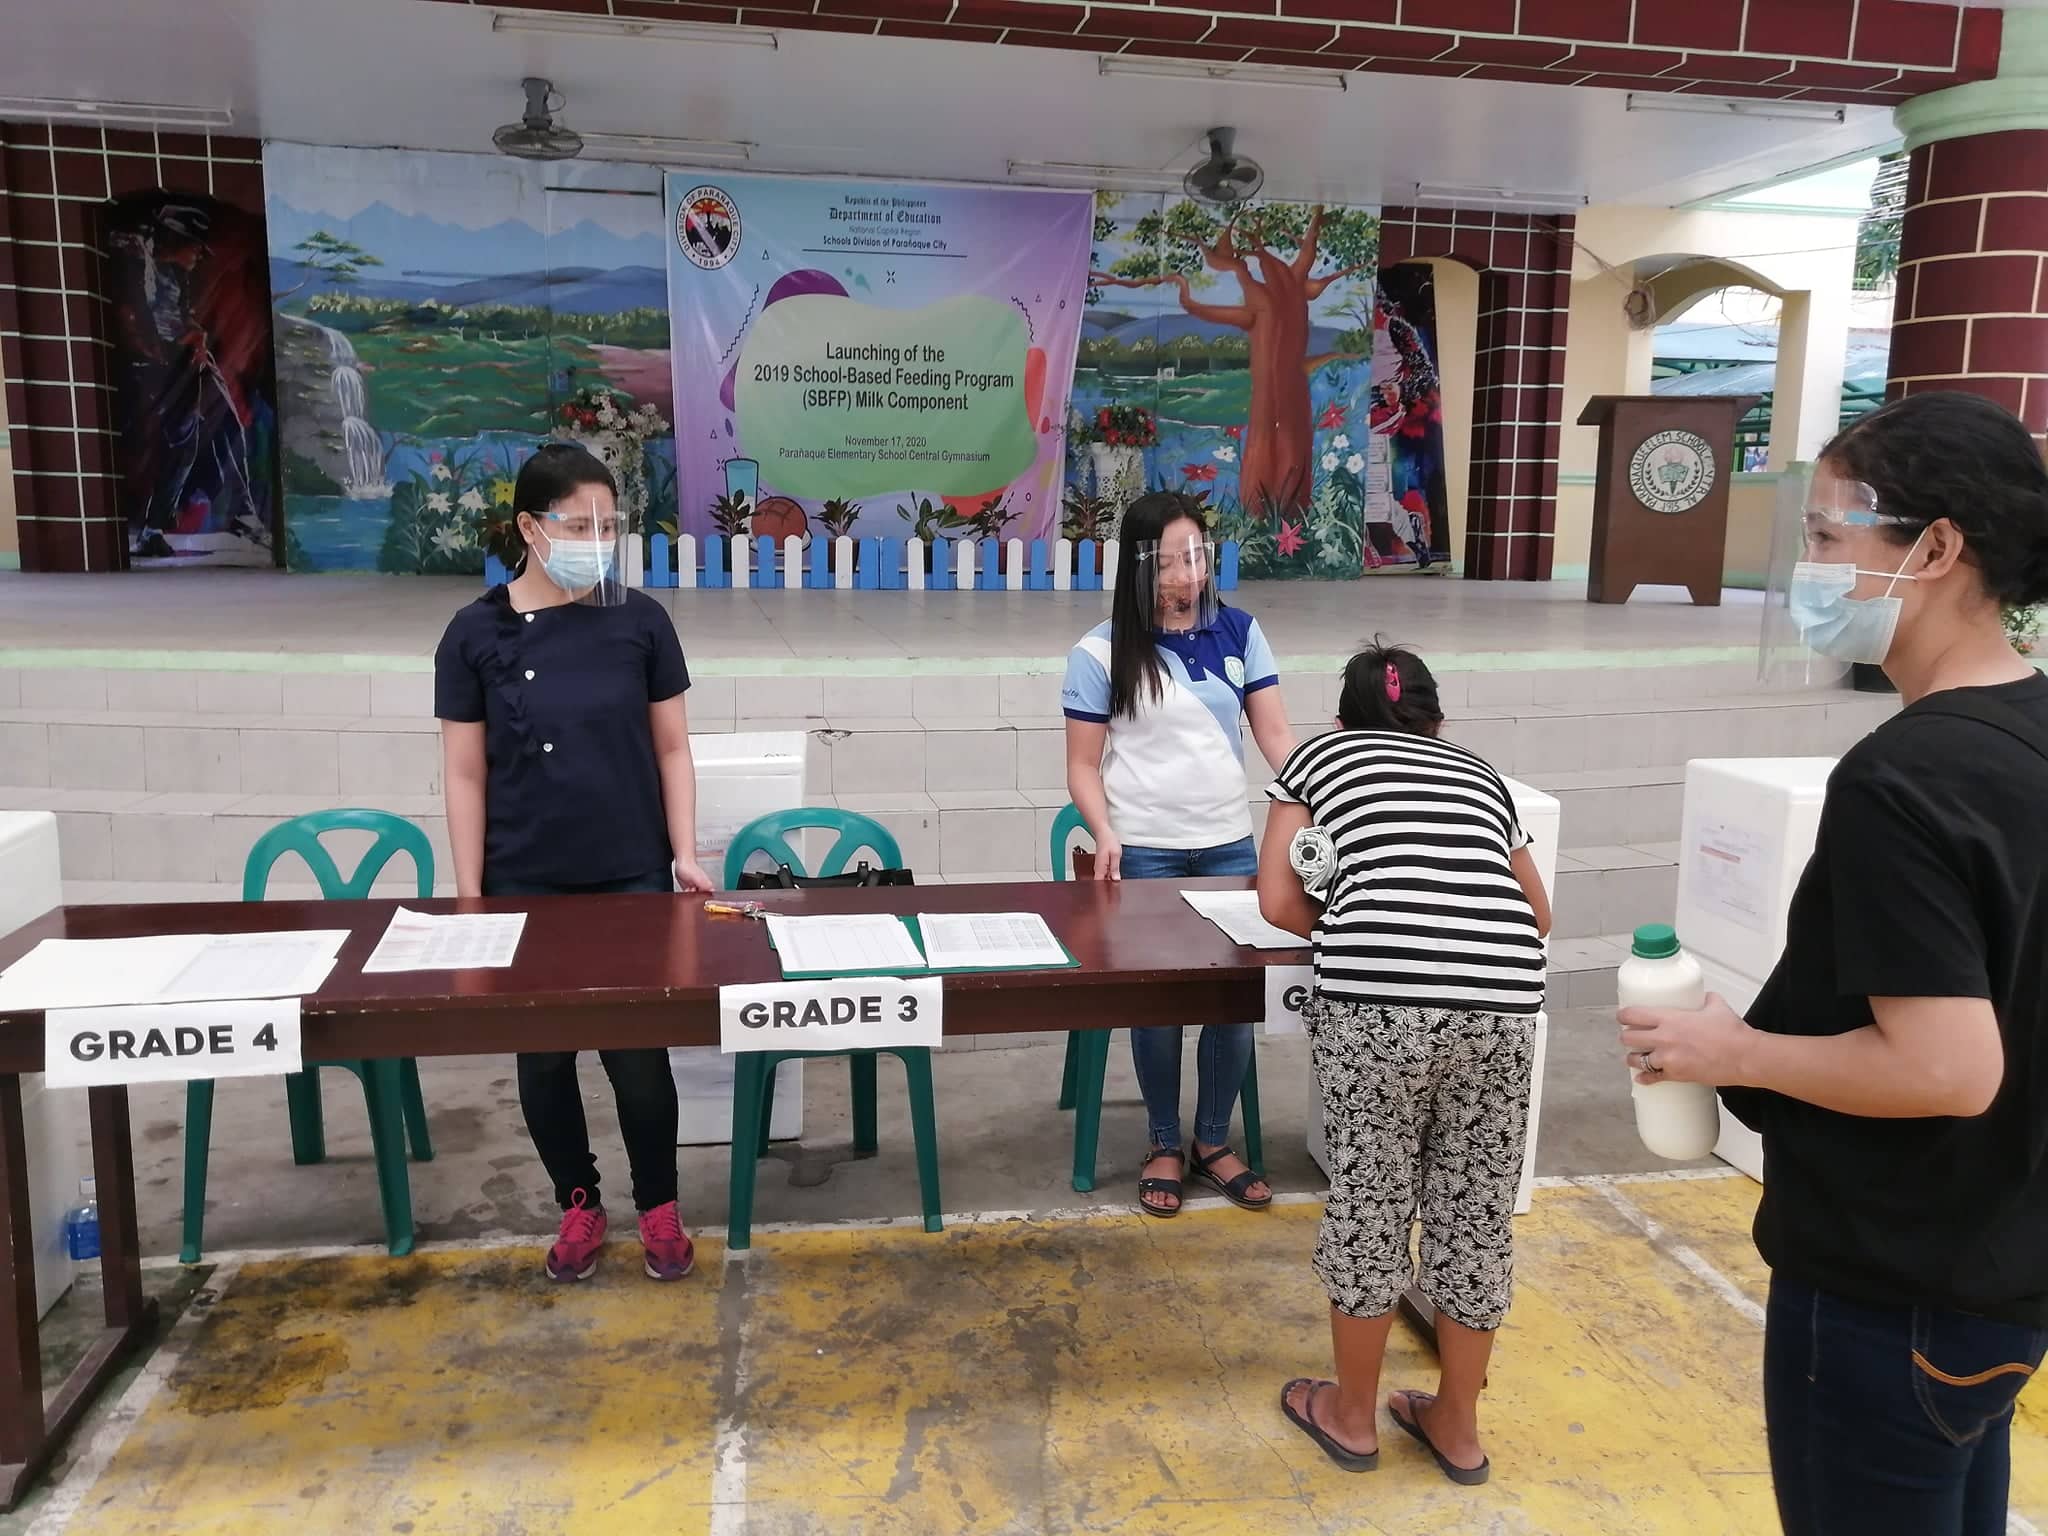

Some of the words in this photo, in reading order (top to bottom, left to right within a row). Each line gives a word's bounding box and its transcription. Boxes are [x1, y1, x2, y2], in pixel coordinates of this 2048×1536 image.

[829, 208, 882, 222] Department
[885, 210, 894, 222] of
[897, 210, 941, 224] Education
[823, 235, 851, 245] Schools
[853, 237, 881, 246] Division
[883, 238, 890, 247] of
[933, 240, 947, 250] City
[826, 342, 900, 365] Launching
[904, 345, 919, 362] of
[923, 345, 945, 362] the
[754, 364, 789, 382] 2019
[793, 365, 892, 384] School-Based
[896, 367, 950, 389] Feeding
[955, 370, 1014, 391] Program
[802, 389, 851, 411] (SBFP)
[856, 391, 884, 408] Milk
[888, 391, 968, 412] Component
[845, 435, 889, 447] November
[891, 436, 904, 448] 17,
[906, 436, 927, 447] 2020
[827, 448, 876, 462] Elementary
[878, 449, 906, 461] School
[909, 450, 940, 461] Central
[942, 450, 991, 463] Gymnasium
[739, 995, 883, 1029] GRADE
[897, 994, 919, 1022] 3
[69, 1024, 235, 1062] GRADE
[252, 1022, 279, 1052] 4
